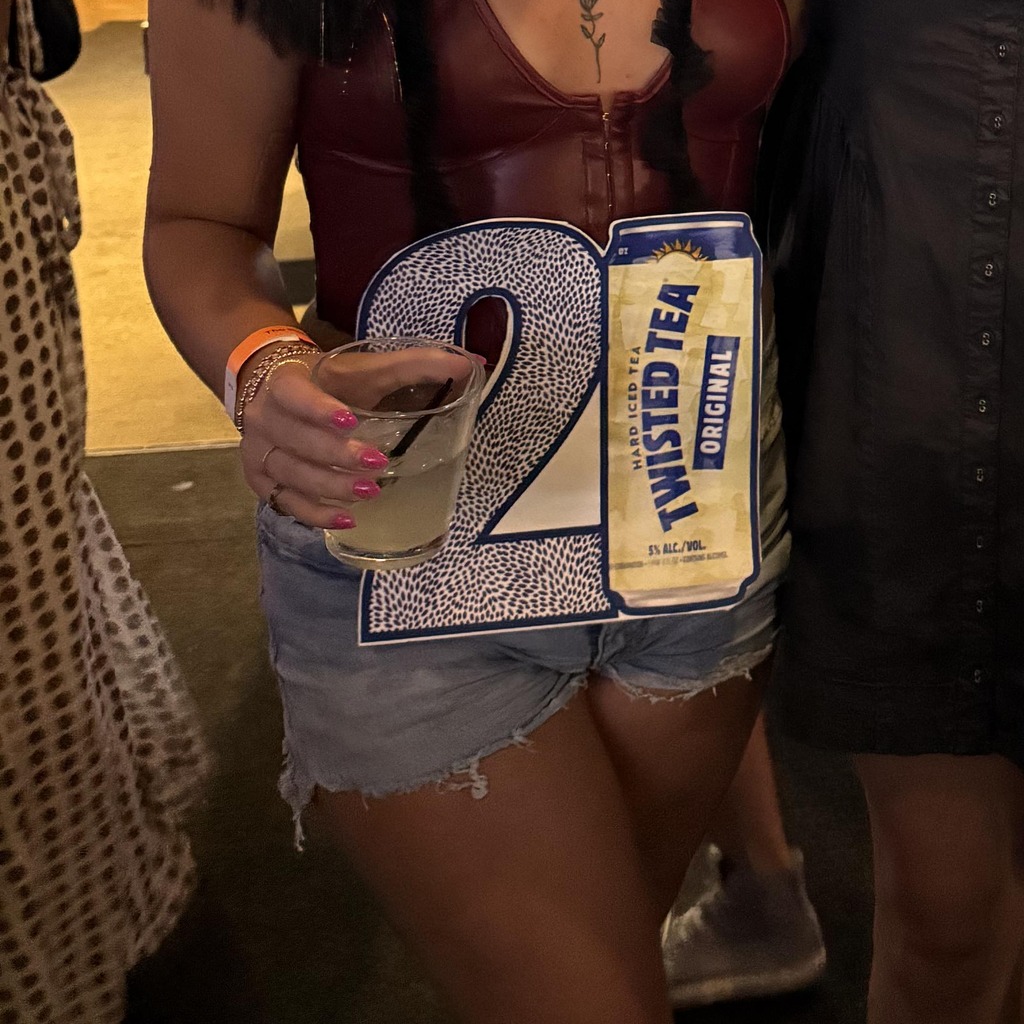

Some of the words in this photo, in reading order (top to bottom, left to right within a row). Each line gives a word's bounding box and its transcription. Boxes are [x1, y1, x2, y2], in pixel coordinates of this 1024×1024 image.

[645, 284, 701, 353] TEA
[629, 346, 642, 375] TEA
[628, 382, 638, 419] ICED
[699, 350, 733, 455] ORIGINAL
[629, 426, 643, 471] HARD
[641, 360, 699, 533] TWISTED
[648, 544, 661, 556] 5%
